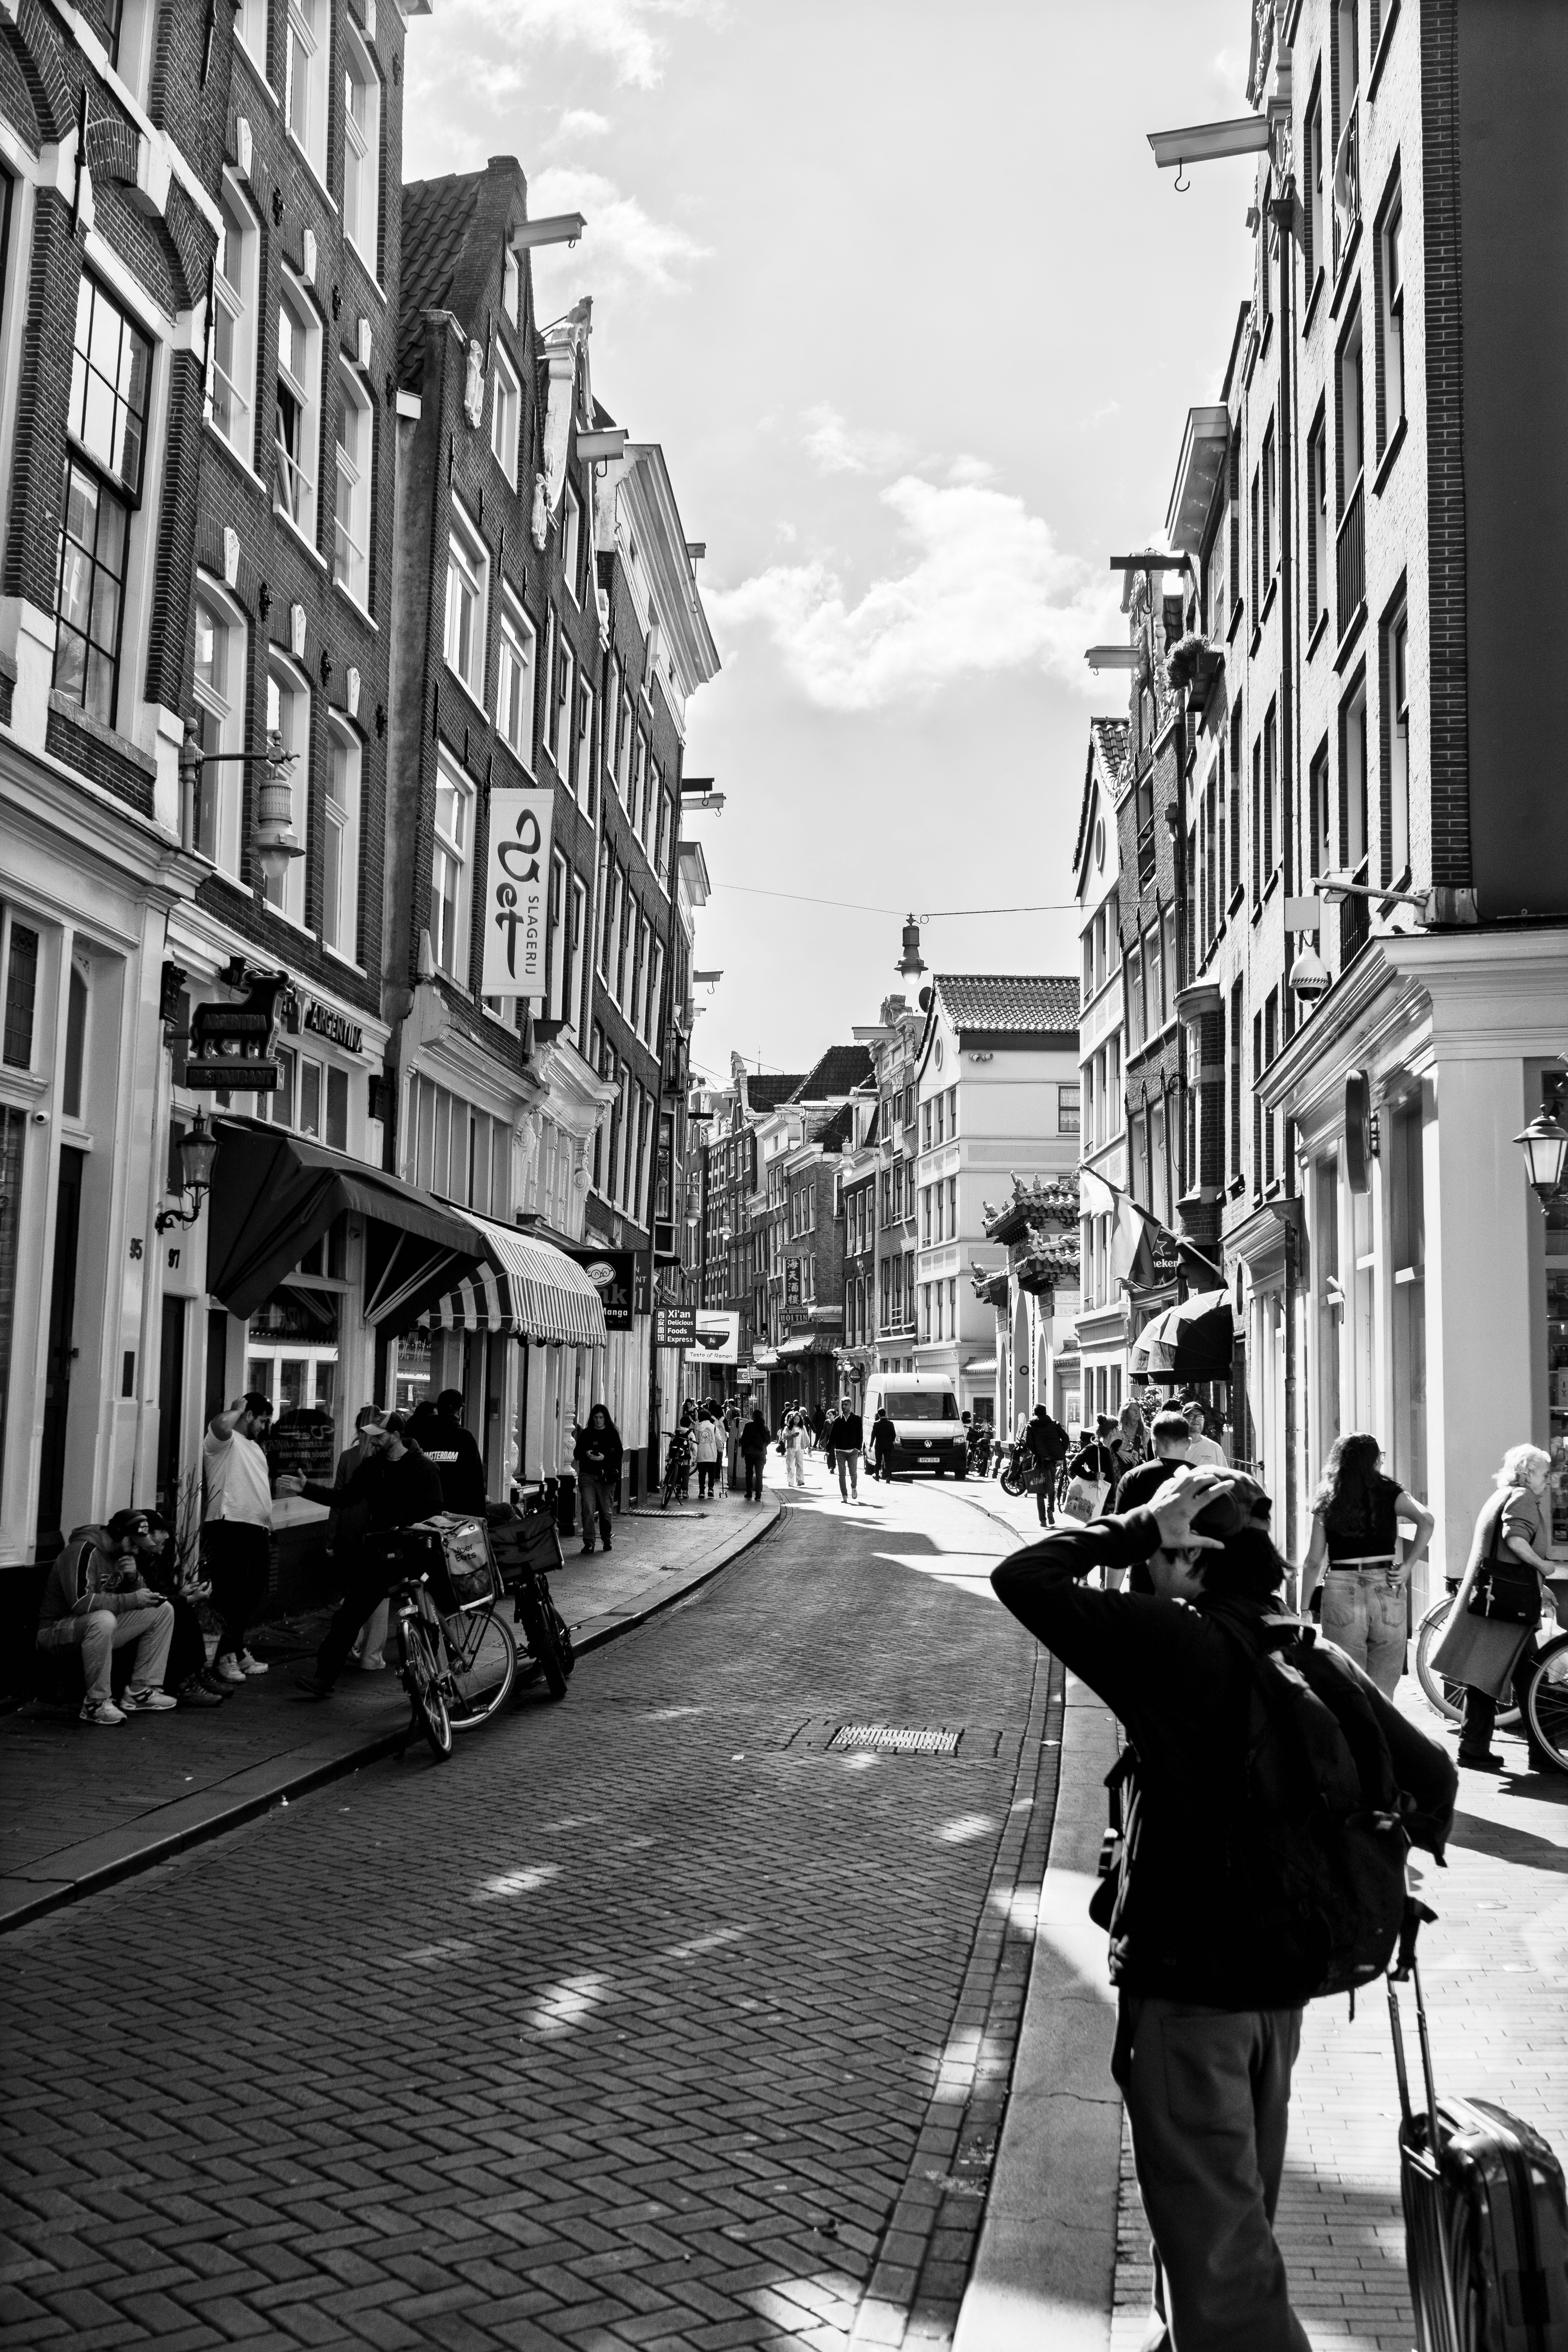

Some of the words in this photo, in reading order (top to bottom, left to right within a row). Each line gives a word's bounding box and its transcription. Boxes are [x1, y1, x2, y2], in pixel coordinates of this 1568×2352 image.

[495, 808, 541, 980] Vet
[526, 895, 539, 975] SLAGERIJ
[201, 1014, 267, 1031] ARGENTINA
[307, 1002, 363, 1053] ARGENTINA
[189, 1069, 274, 1085] RESTAURANT
[130, 1238, 143, 1259] 95
[169, 1248, 180, 1269] 97
[787, 1259, 799, 1305] 海天酒樓
[668, 1310, 690, 1318] Xi'an
[455, 1553, 476, 1562] Eats
